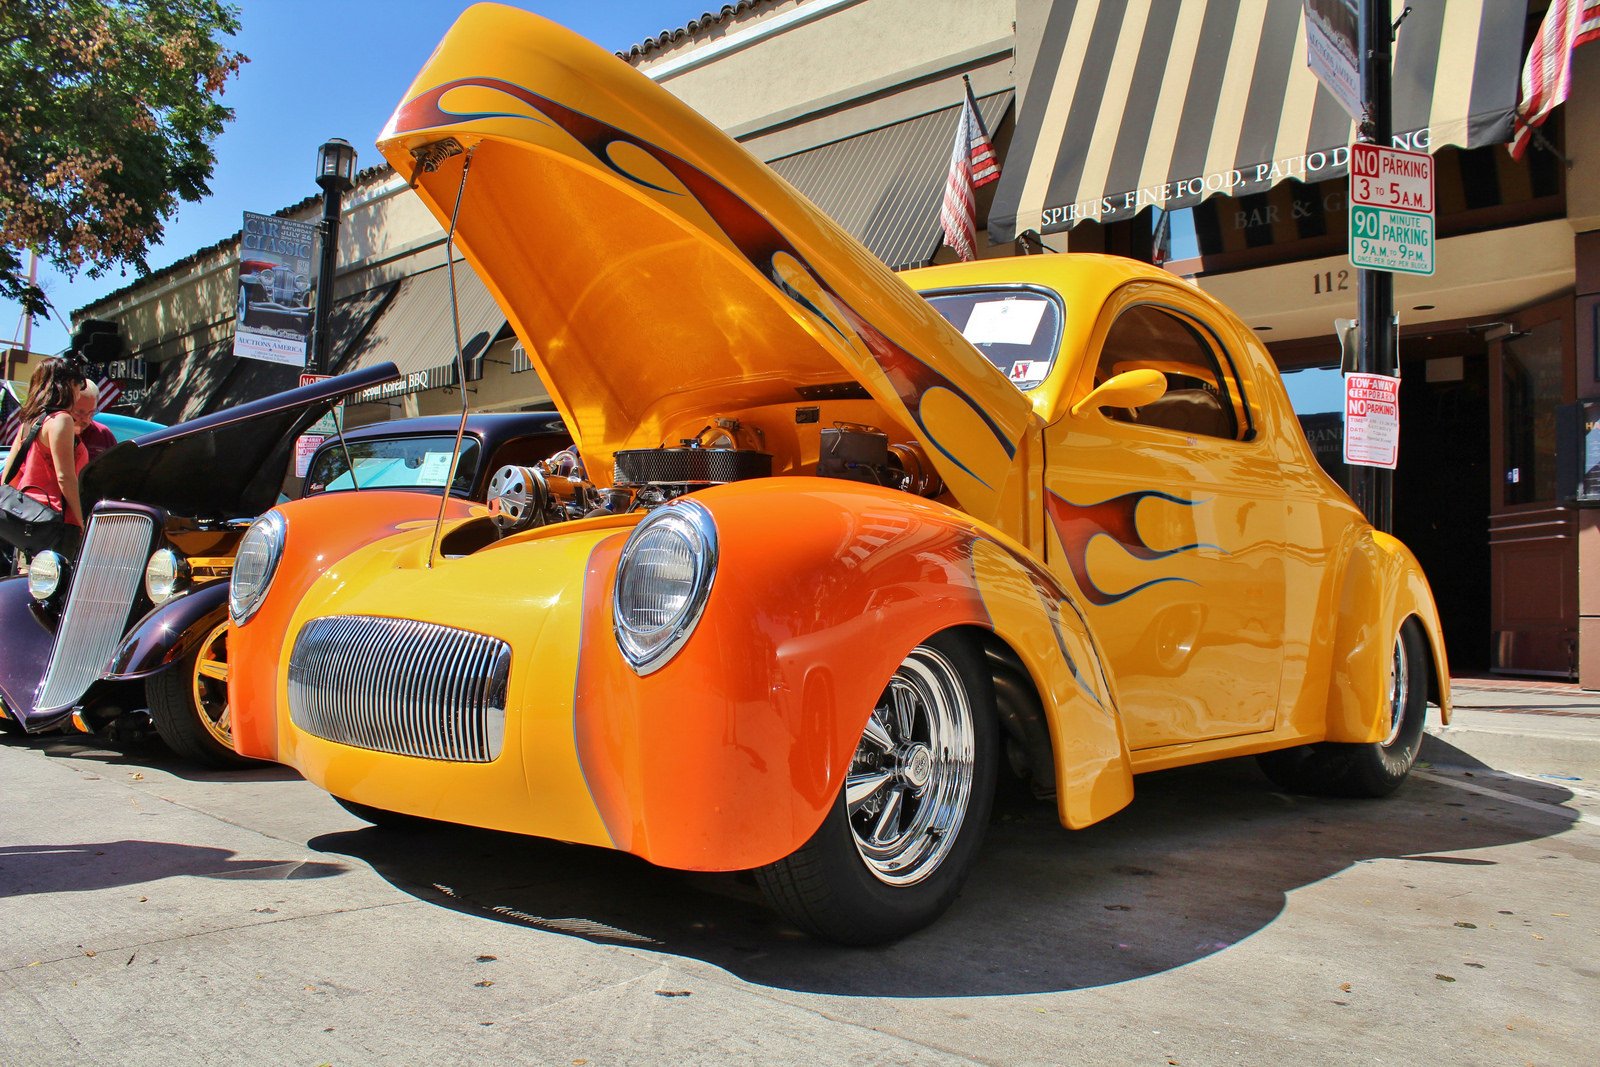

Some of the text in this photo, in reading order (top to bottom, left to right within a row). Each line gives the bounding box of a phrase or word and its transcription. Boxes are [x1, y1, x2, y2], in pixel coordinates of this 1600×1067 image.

[1354, 149, 1428, 179] NO PARKING
[1041, 128, 1432, 226] SPIRITS, FINE FOOD, PATIO DNG
[1359, 178, 1370, 200] 3
[1375, 187, 1385, 196] TO
[246, 213, 282, 223] DOWNTOWN
[1234, 205, 1280, 230] BAR
[1291, 200, 1312, 219] &
[1354, 210, 1421, 237] 90 MINUTE
[244, 219, 279, 238] CAR
[281, 225, 313, 235] SATURDAY
[281, 230, 312, 241] JULY 26
[1383, 225, 1428, 247] PARKING
[244, 234, 311, 259] CLASSIC
[1358, 255, 1372, 263] ONCE
[1375, 257, 1385, 265] PER
[1411, 261, 1428, 270] BLOCK
[1313, 270, 1349, 294] 112
[239, 337, 271, 348] AUCTIONS
[272, 342, 303, 353] AMERICA
[108, 360, 144, 380] GRILL
[382, 379, 407, 393] Korean
[409, 371, 429, 388] BBQ
[1351, 377, 1394, 392] TOW-AWAY
[1352, 389, 1393, 400] TEMPORARY
[1349, 400, 1394, 416] NO PARKING
